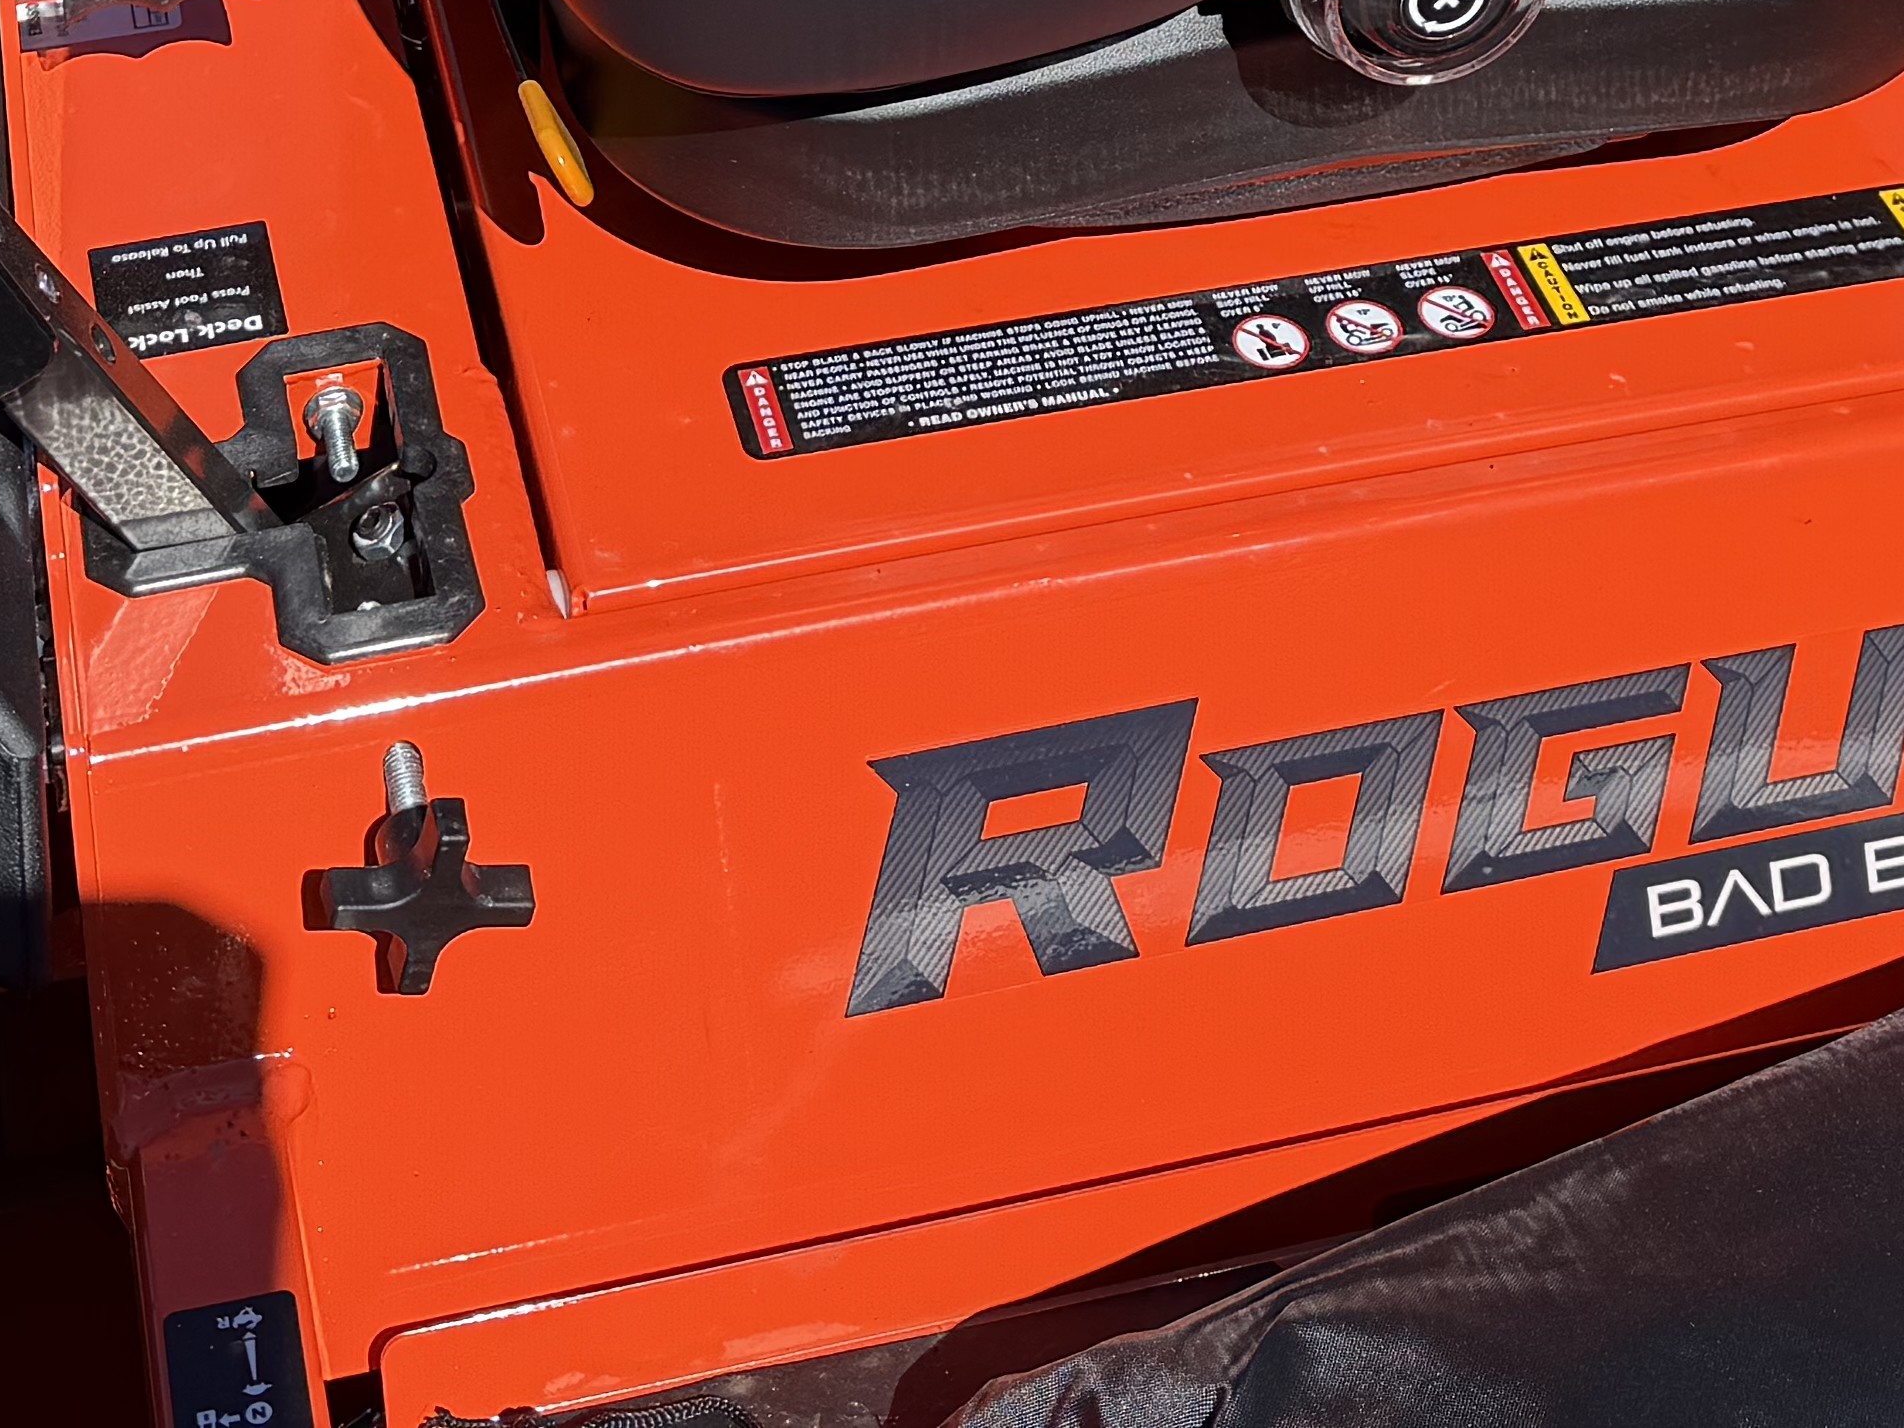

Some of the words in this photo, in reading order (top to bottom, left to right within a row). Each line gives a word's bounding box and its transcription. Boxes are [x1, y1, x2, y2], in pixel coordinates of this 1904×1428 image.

[172, 243, 192, 253] To
[193, 238, 216, 251] Up
[220, 233, 248, 248] Pull
[111, 246, 169, 263] Release
[165, 266, 204, 281] Then
[1562, 259, 1602, 272] Never
[212, 285, 250, 300] Press
[1499, 268, 1541, 326] DANGER
[1538, 261, 1580, 319] CAUTION
[127, 298, 170, 315] Assist
[175, 293, 208, 307] Foot
[197, 314, 263, 340] Deck
[128, 327, 190, 352] Lock
[918, 411, 963, 427] READ
[966, 398, 1039, 419] OWNER'S
[1042, 387, 1110, 407] MANUAL
[753, 386, 782, 448] DANGER
[1648, 852, 1833, 938] BAD
